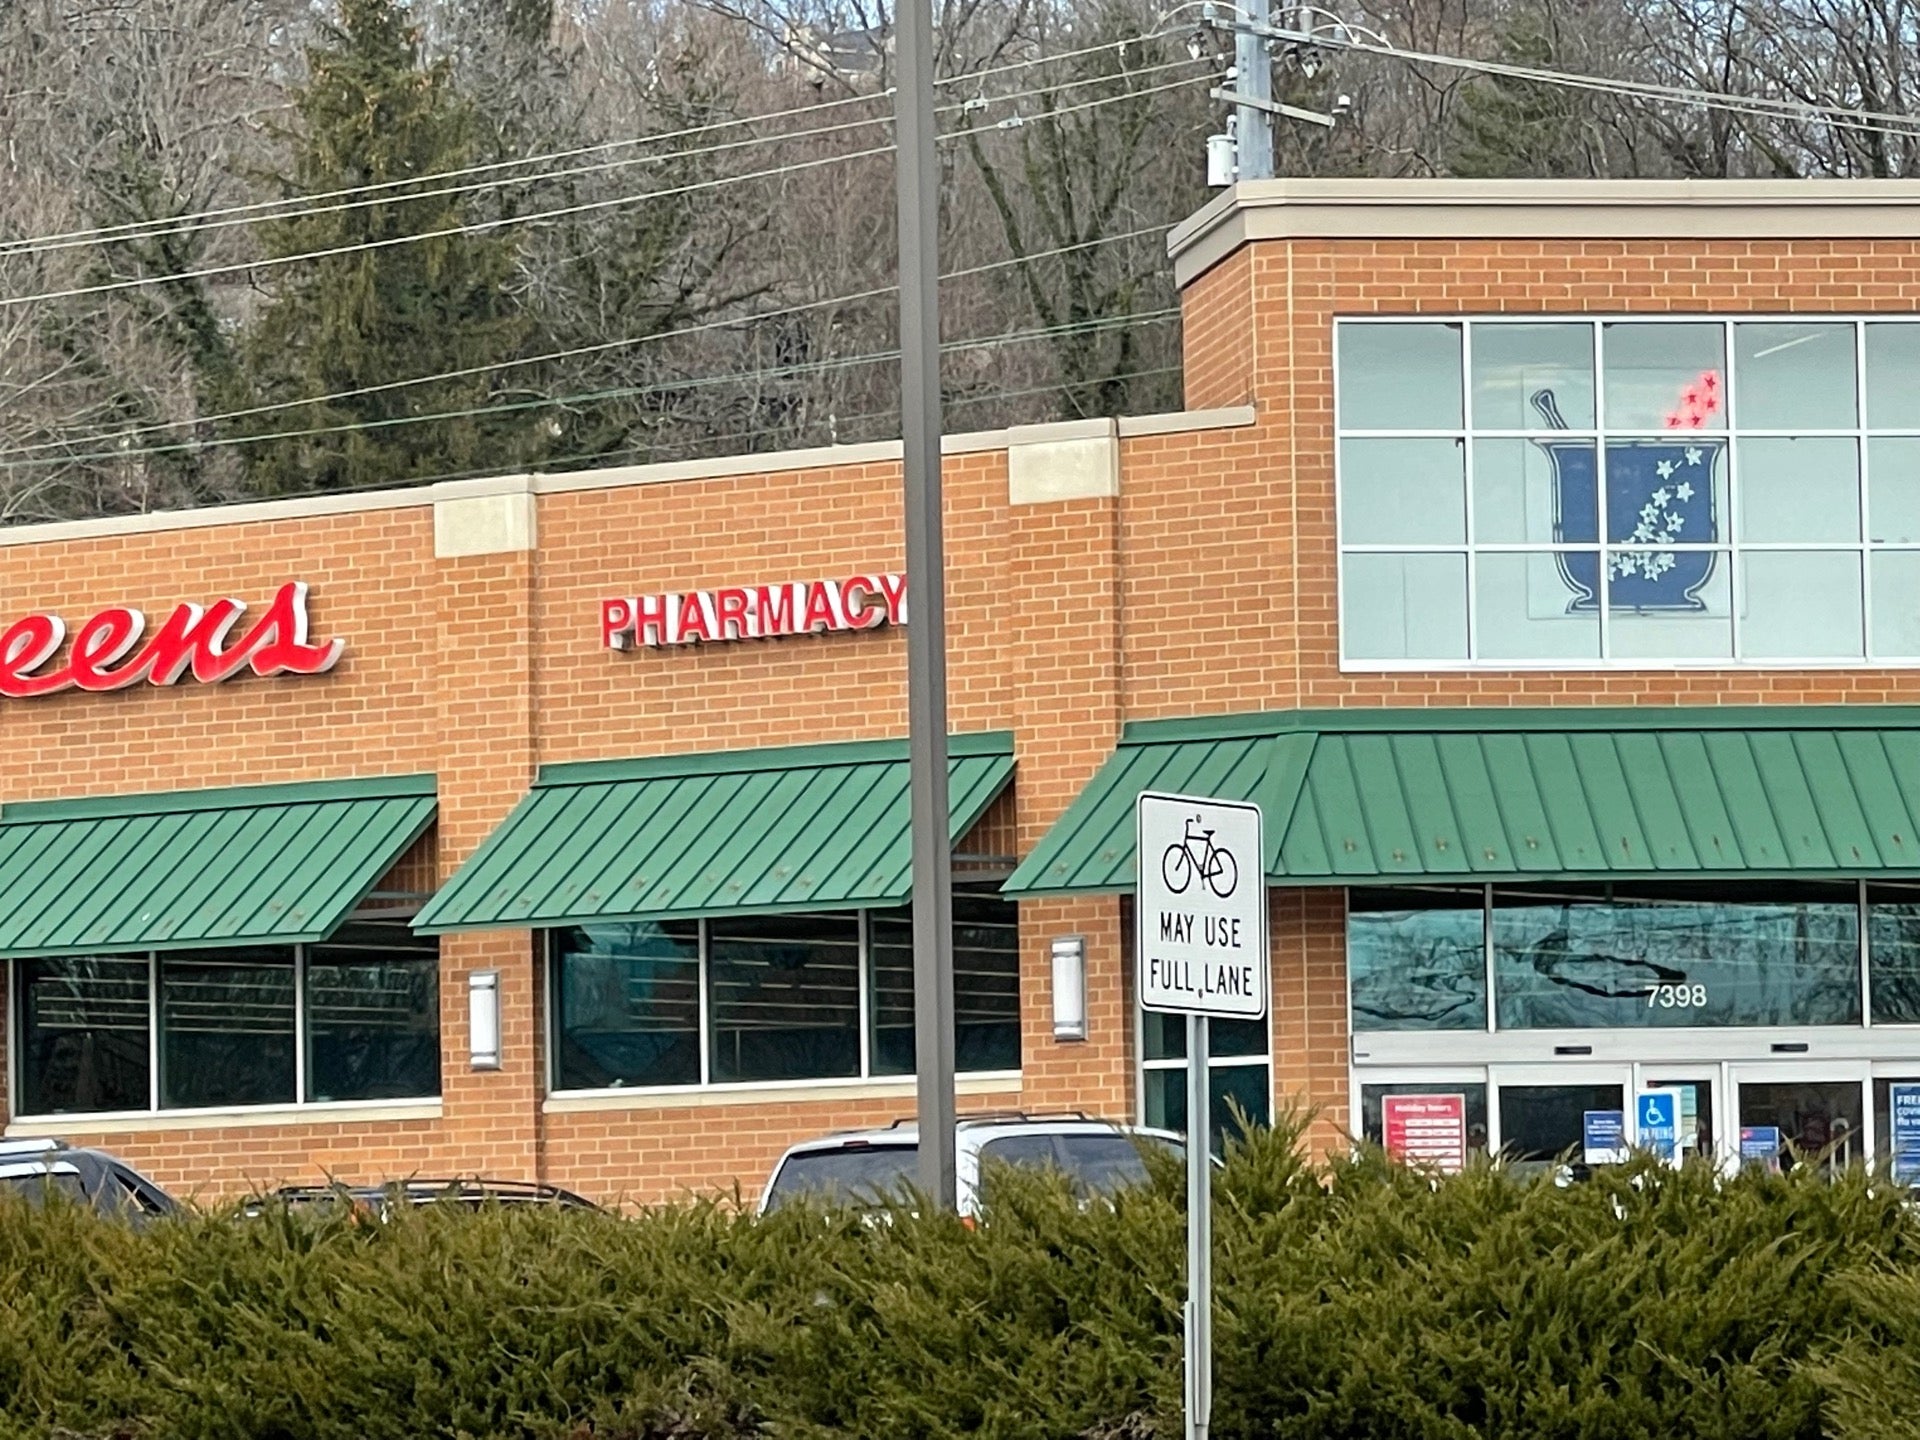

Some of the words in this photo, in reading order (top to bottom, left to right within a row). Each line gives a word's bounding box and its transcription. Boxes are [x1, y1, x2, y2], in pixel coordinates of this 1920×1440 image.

[602, 575, 908, 648] PHARMACY
[1160, 911, 1194, 943] MAY
[1205, 916, 1241, 948] USE
[1151, 958, 1194, 992] FULL
[1205, 963, 1252, 996] LANE
[1644, 984, 1707, 1008] 7398
[1896, 1095, 1920, 1105] FRE
